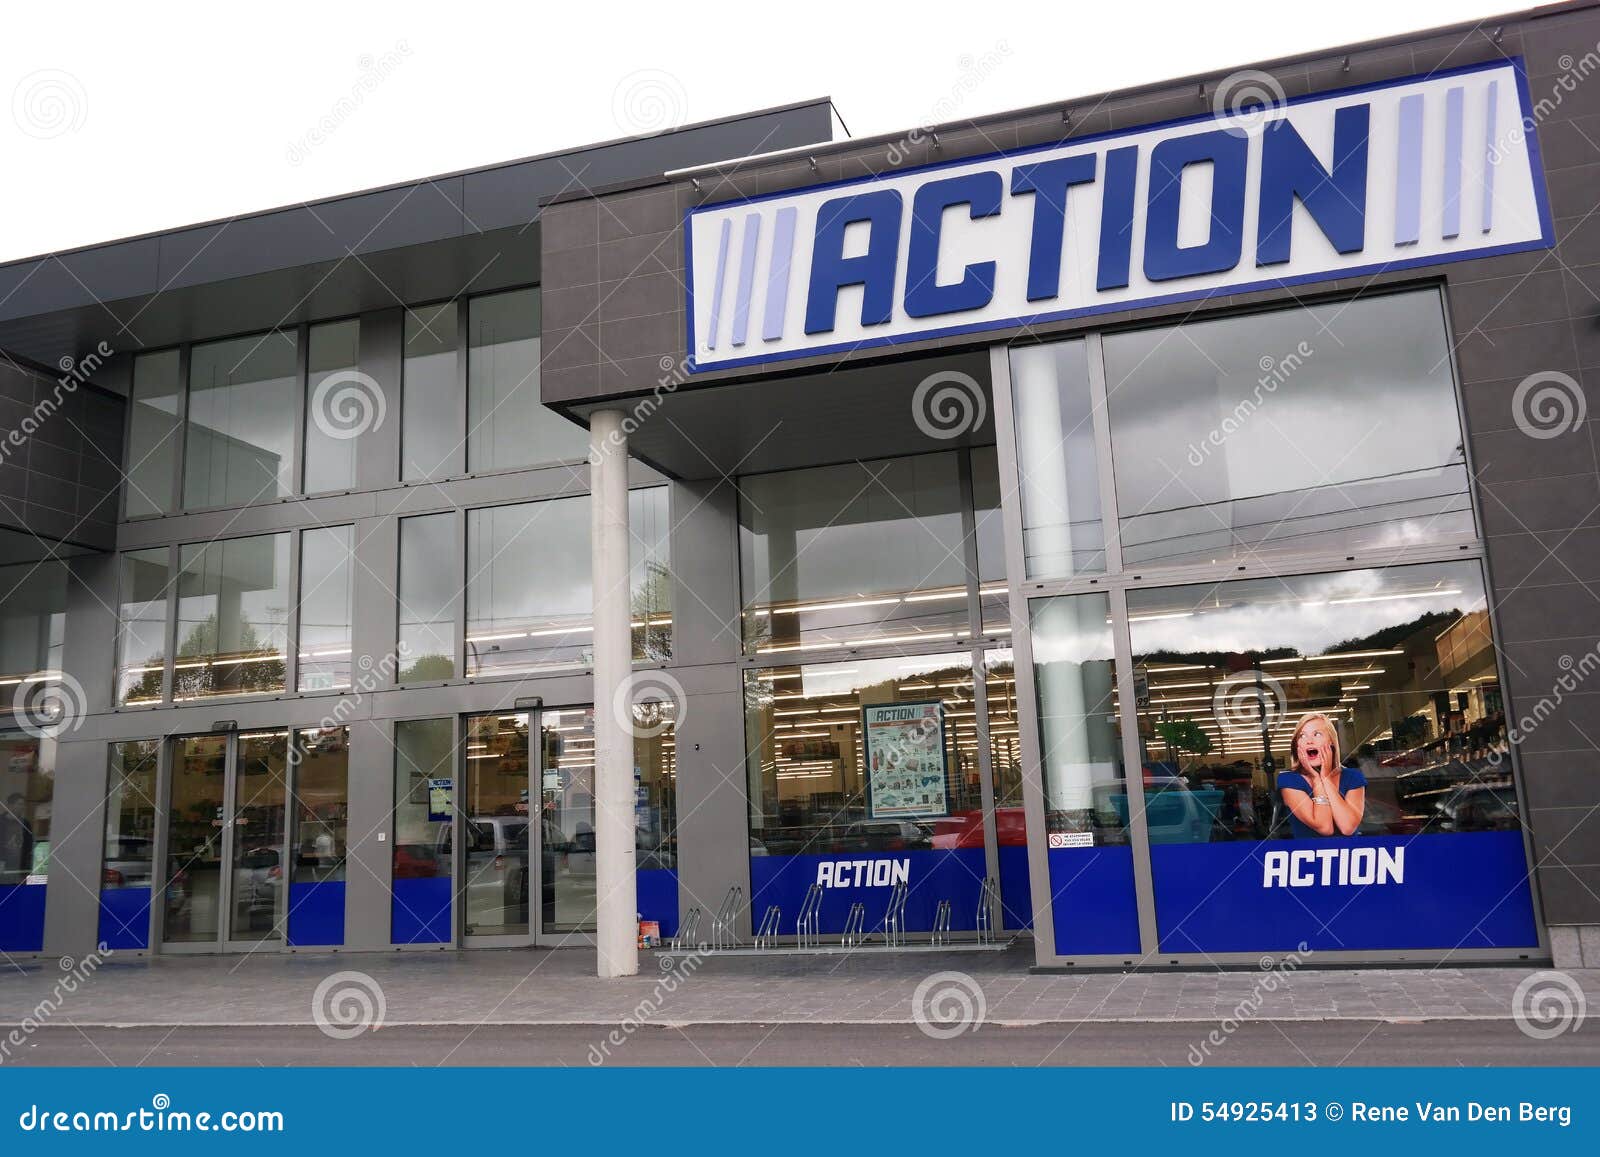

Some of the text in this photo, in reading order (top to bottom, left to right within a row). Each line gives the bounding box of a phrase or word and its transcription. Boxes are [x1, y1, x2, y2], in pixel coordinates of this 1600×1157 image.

[804, 102, 1371, 336] ACTION
[876, 708, 915, 721] ACTION
[816, 858, 911, 889] ACTION
[1263, 846, 1405, 888] ACTION
